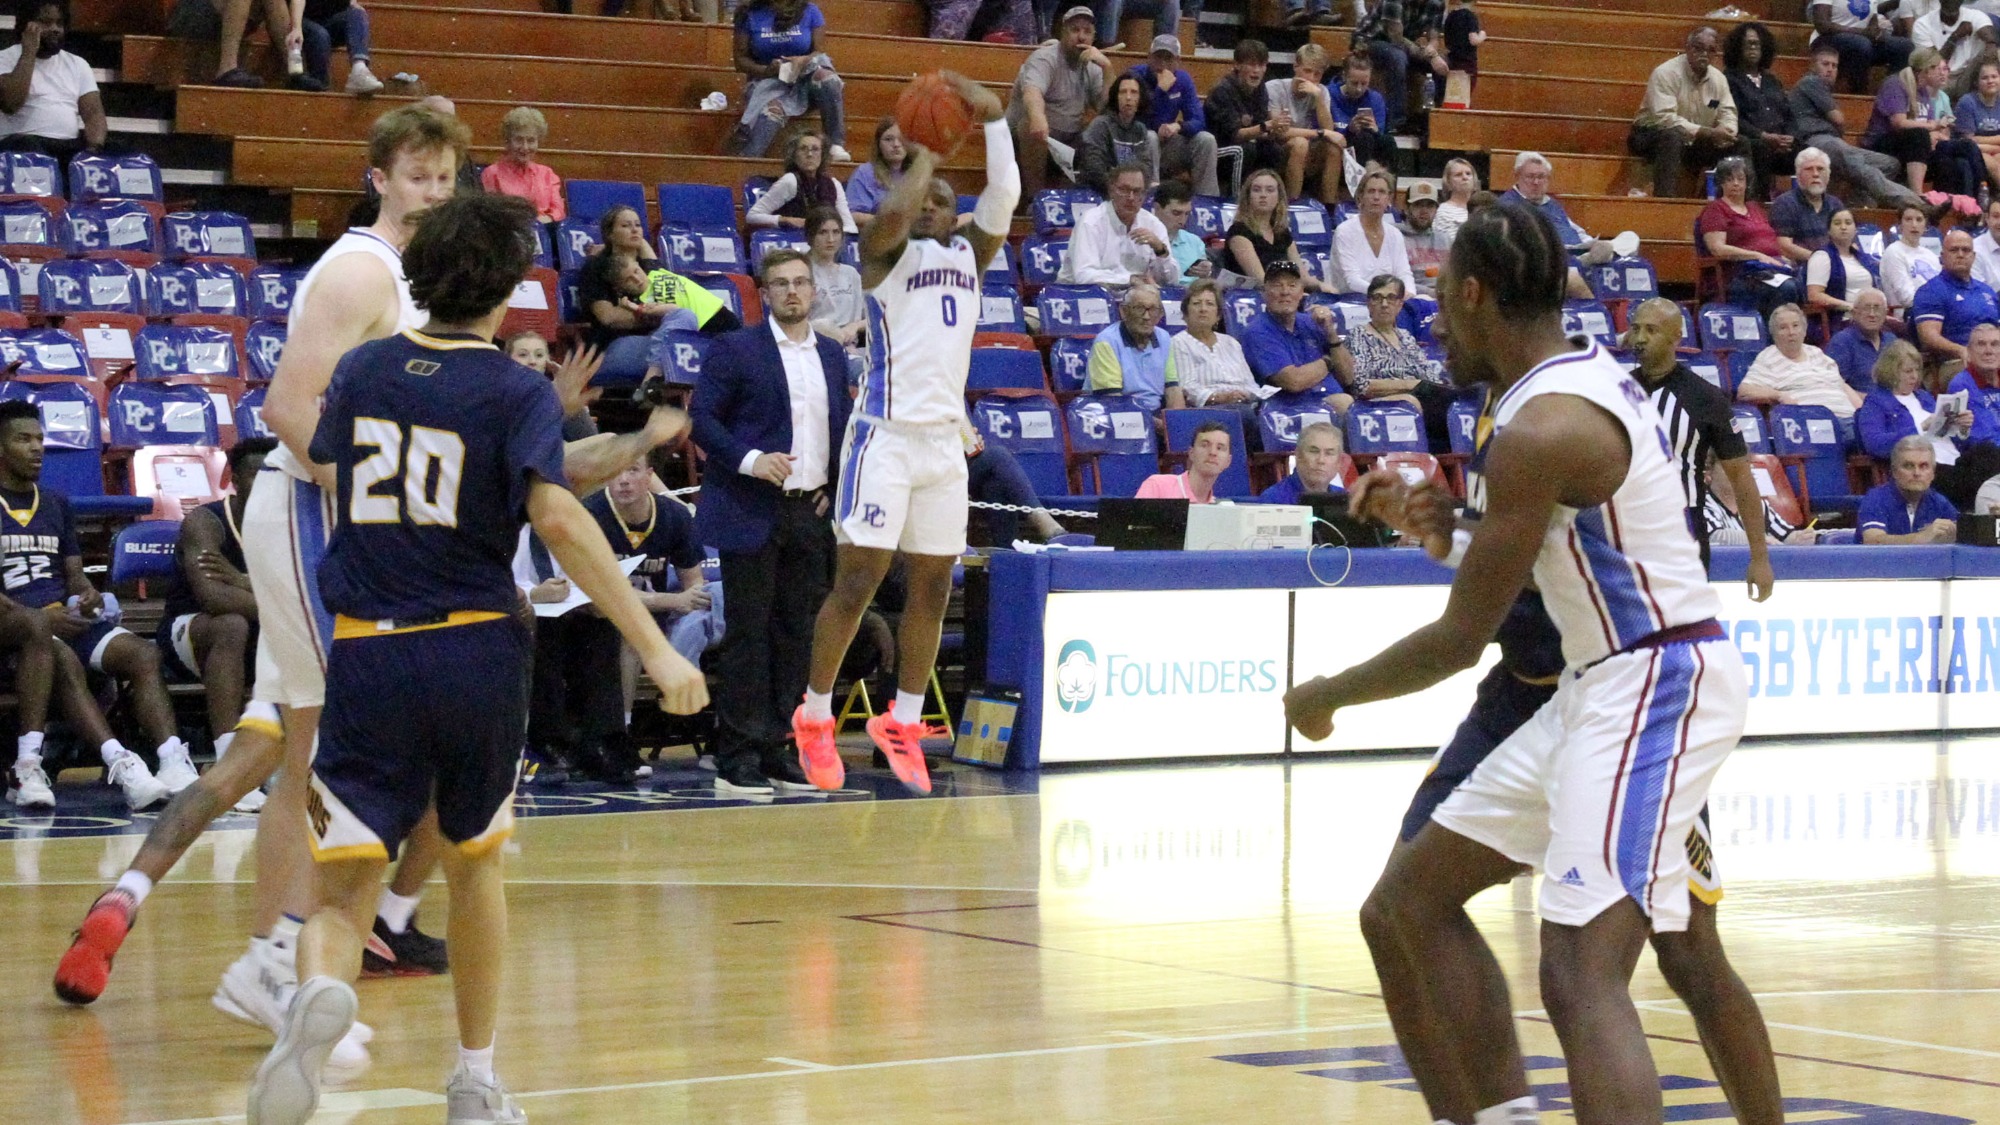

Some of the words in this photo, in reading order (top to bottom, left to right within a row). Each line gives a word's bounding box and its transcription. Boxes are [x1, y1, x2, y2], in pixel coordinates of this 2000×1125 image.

[84, 165, 110, 193] PC
[1043, 202, 1067, 225] PC
[1196, 207, 1217, 232] PC
[72, 219, 100, 247] PC
[174, 224, 201, 253] PC
[670, 235, 695, 261] PC
[1030, 247, 1054, 273] PC
[54, 275, 82, 305] PC
[161, 276, 188, 306] PC
[1602, 268, 1620, 291] PC
[261, 279, 288, 309] PC
[941, 295, 957, 327] 0
[1052, 298, 1073, 324] PC
[1708, 315, 1728, 339] PC
[149, 340, 178, 370] PC
[675, 343, 700, 373] PC
[1063, 353, 1085, 379] PC
[123, 400, 155, 432] PC
[986, 410, 1013, 438] PC
[1357, 415, 1381, 442] PC
[1781, 418, 1804, 443] PC
[350, 417, 465, 528] 20
[862, 503, 886, 528] PC
[2, 555, 53, 590] 22
